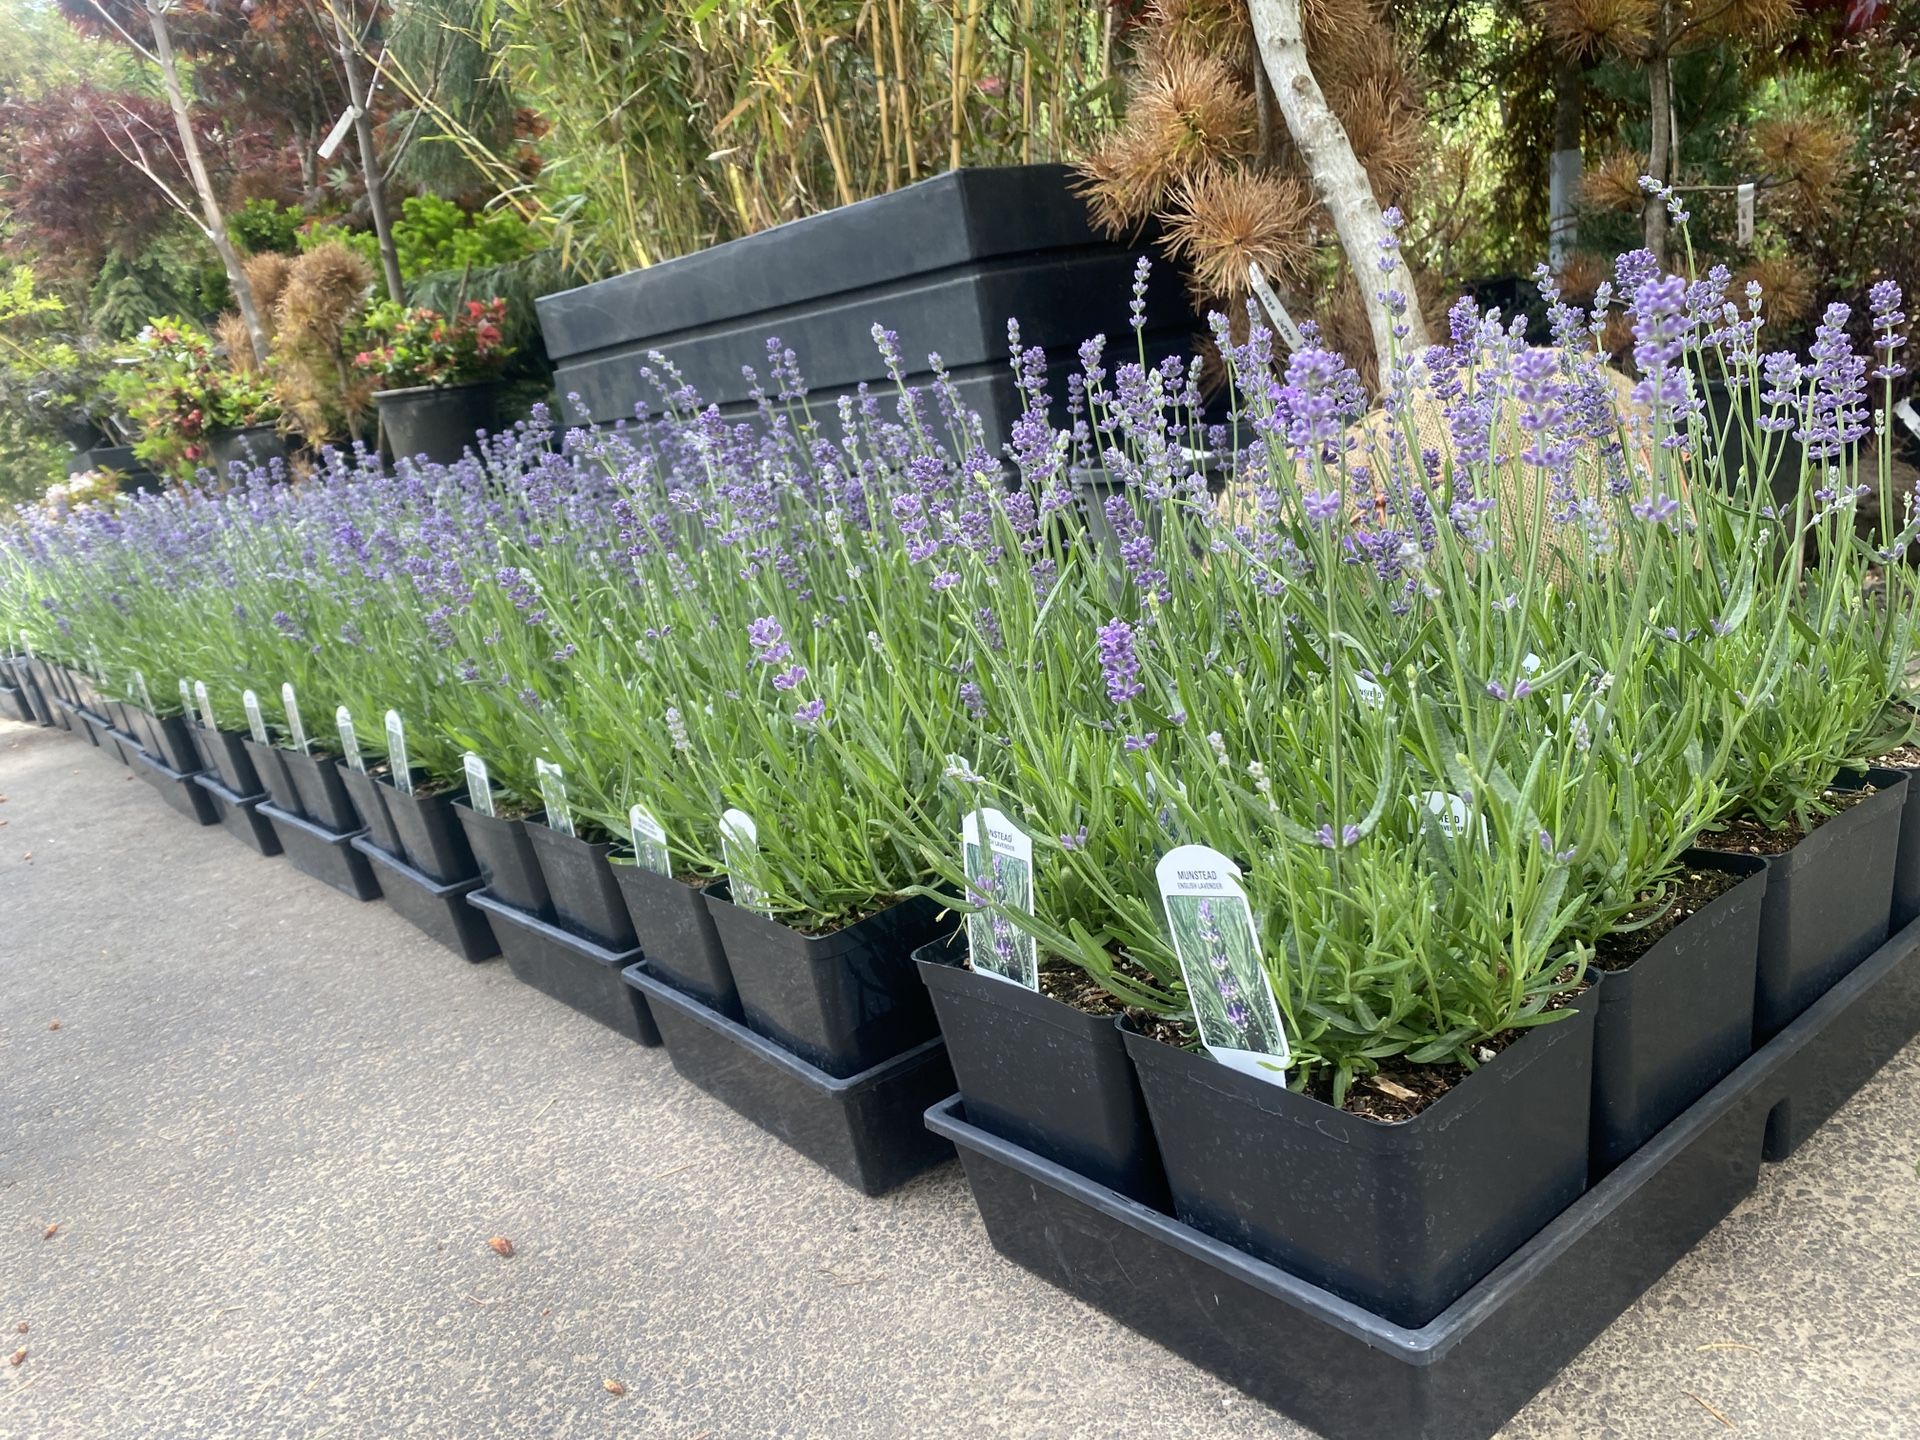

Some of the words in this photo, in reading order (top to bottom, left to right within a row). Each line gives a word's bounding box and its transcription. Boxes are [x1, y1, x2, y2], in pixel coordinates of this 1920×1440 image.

[1177, 870, 1217, 880] MUNSTEAD
[1177, 882, 1197, 890] ENGLISH
[1198, 882, 1223, 890] LAVENDER
